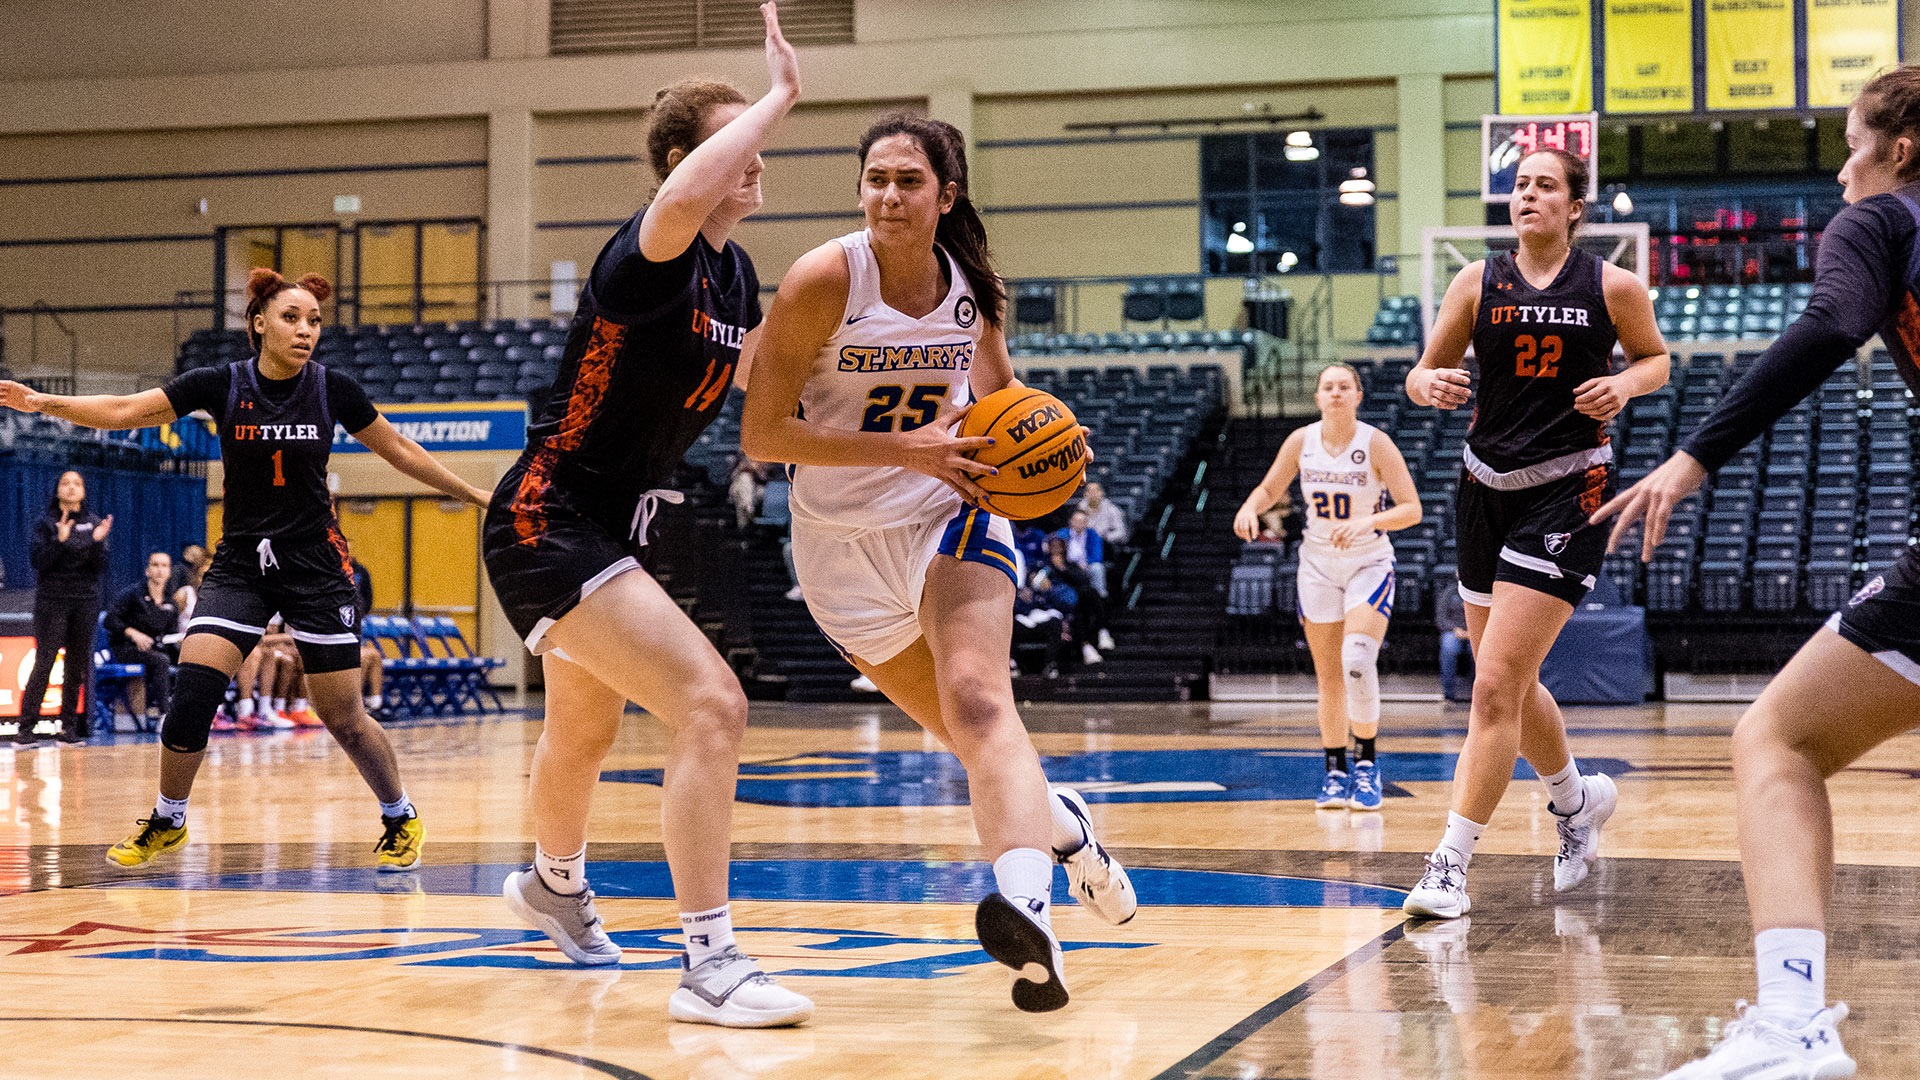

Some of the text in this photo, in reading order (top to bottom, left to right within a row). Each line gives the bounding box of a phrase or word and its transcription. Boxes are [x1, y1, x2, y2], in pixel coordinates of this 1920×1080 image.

[1514, 334, 1563, 378] 22
[684, 359, 731, 411] 14
[859, 383, 950, 432] 25
[1006, 403, 1063, 443] NCAA
[271, 449, 285, 487] 1
[1017, 434, 1085, 479] Wilson
[1311, 491, 1352, 519] 20
